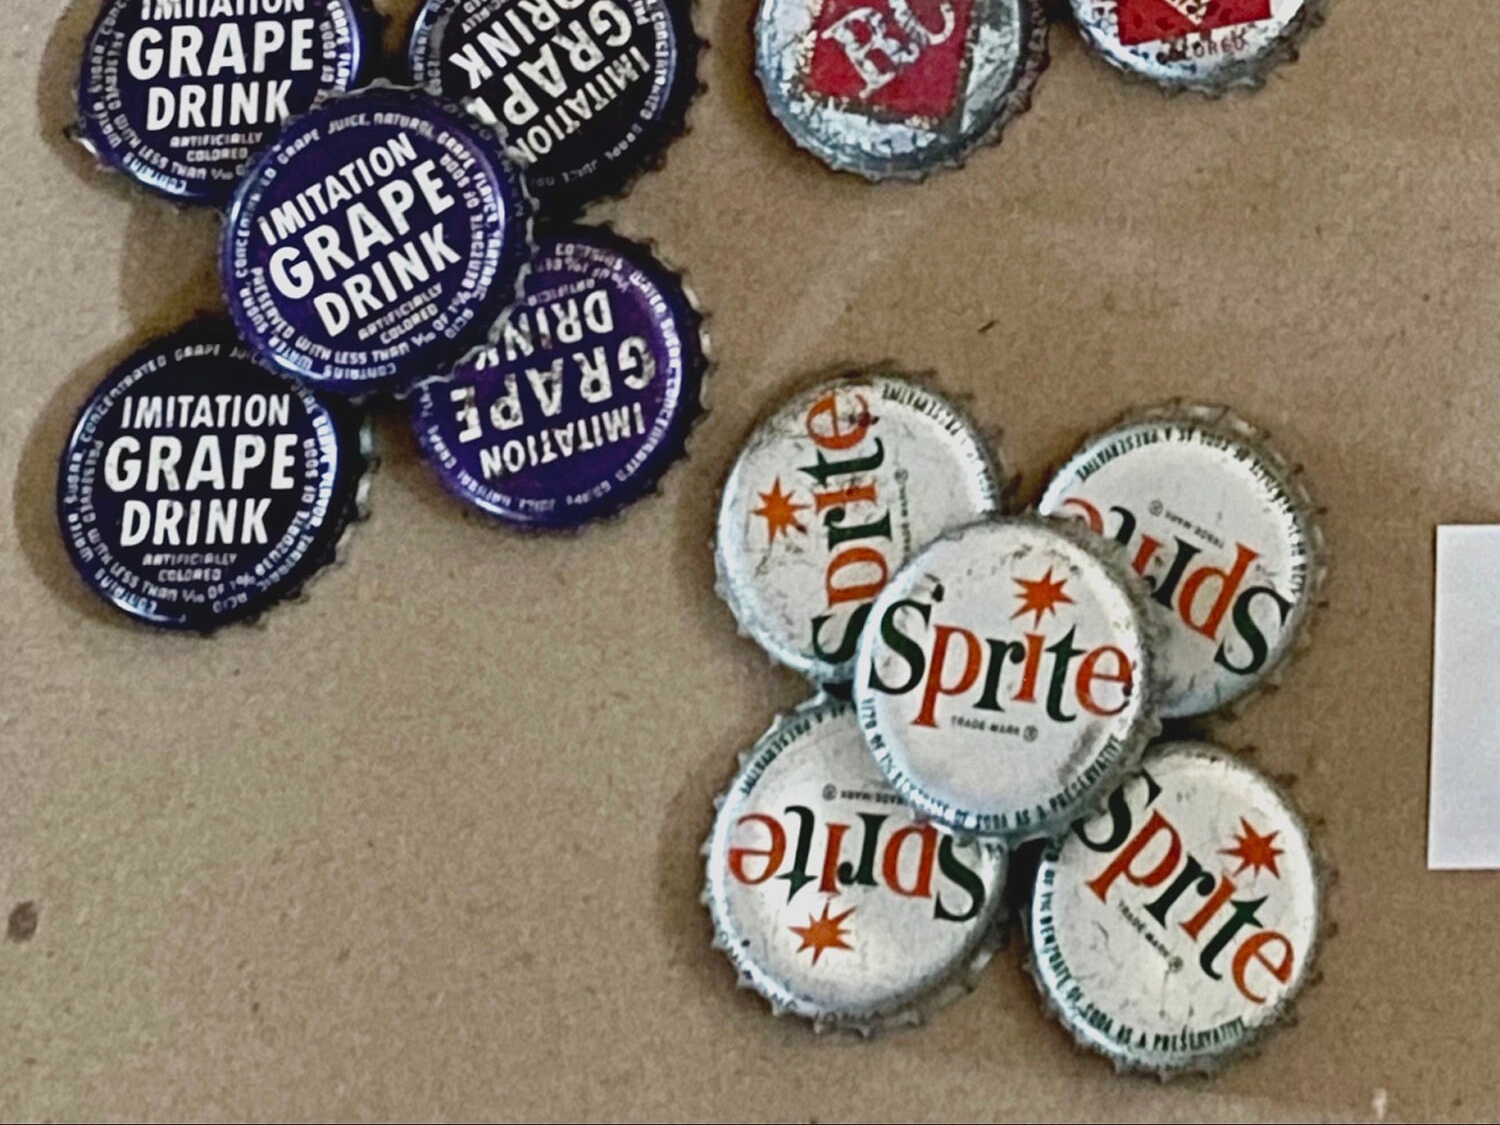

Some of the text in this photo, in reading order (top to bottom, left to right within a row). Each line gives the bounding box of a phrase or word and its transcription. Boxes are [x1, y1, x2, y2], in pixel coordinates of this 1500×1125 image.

[126, 18, 315, 81] GRAPE
[146, 79, 293, 131] DRINK
[515, 45, 651, 164] IMITATION
[138, 144, 170, 171] LESS
[170, 160, 206, 181] THAN
[169, 132, 263, 148] ARTIFICIALLY
[186, 147, 249, 163] COLORED
[276, 128, 321, 166] GRAPE
[373, 111, 436, 141] NATURAL
[436, 130, 477, 171] GRAPE
[258, 131, 419, 247] IMITATION
[439, 152, 471, 189] SODA
[269, 158, 455, 300] GRAPE
[250, 266, 296, 339] PRESERVED
[313, 222, 463, 338] DRINK
[357, 282, 443, 342] ARTIFICIALLY
[379, 303, 440, 346] COLORED
[431, 311, 451, 333] OF
[294, 334, 334, 362] WITH
[334, 349, 368, 366] LESS
[371, 340, 412, 364] THAN
[120, 393, 291, 430] IMITATION
[450, 335, 657, 444] GRAPE
[104, 434, 299, 493] GRAPE
[479, 402, 646, 481] IMITATION
[120, 497, 273, 548] DRINK
[797, 387, 893, 665] Sprite
[109, 561, 141, 589] LESS
[140, 578, 179, 603] THAN
[206, 583, 226, 601] OF
[142, 552, 238, 567] ARTIFICIALLY
[157, 567, 223, 582] COLORED
[868, 598, 1137, 729] Sprite
[1014, 809, 1032, 826] AS
[1037, 804, 1048, 819] A
[1049, 733, 1123, 814] PRESERVATIVE
[728, 805, 987, 923] Sprite
[1069, 769, 1295, 1006] Sprite
[1080, 1001, 1249, 1053] SODA AS A PRESERVATIVE
